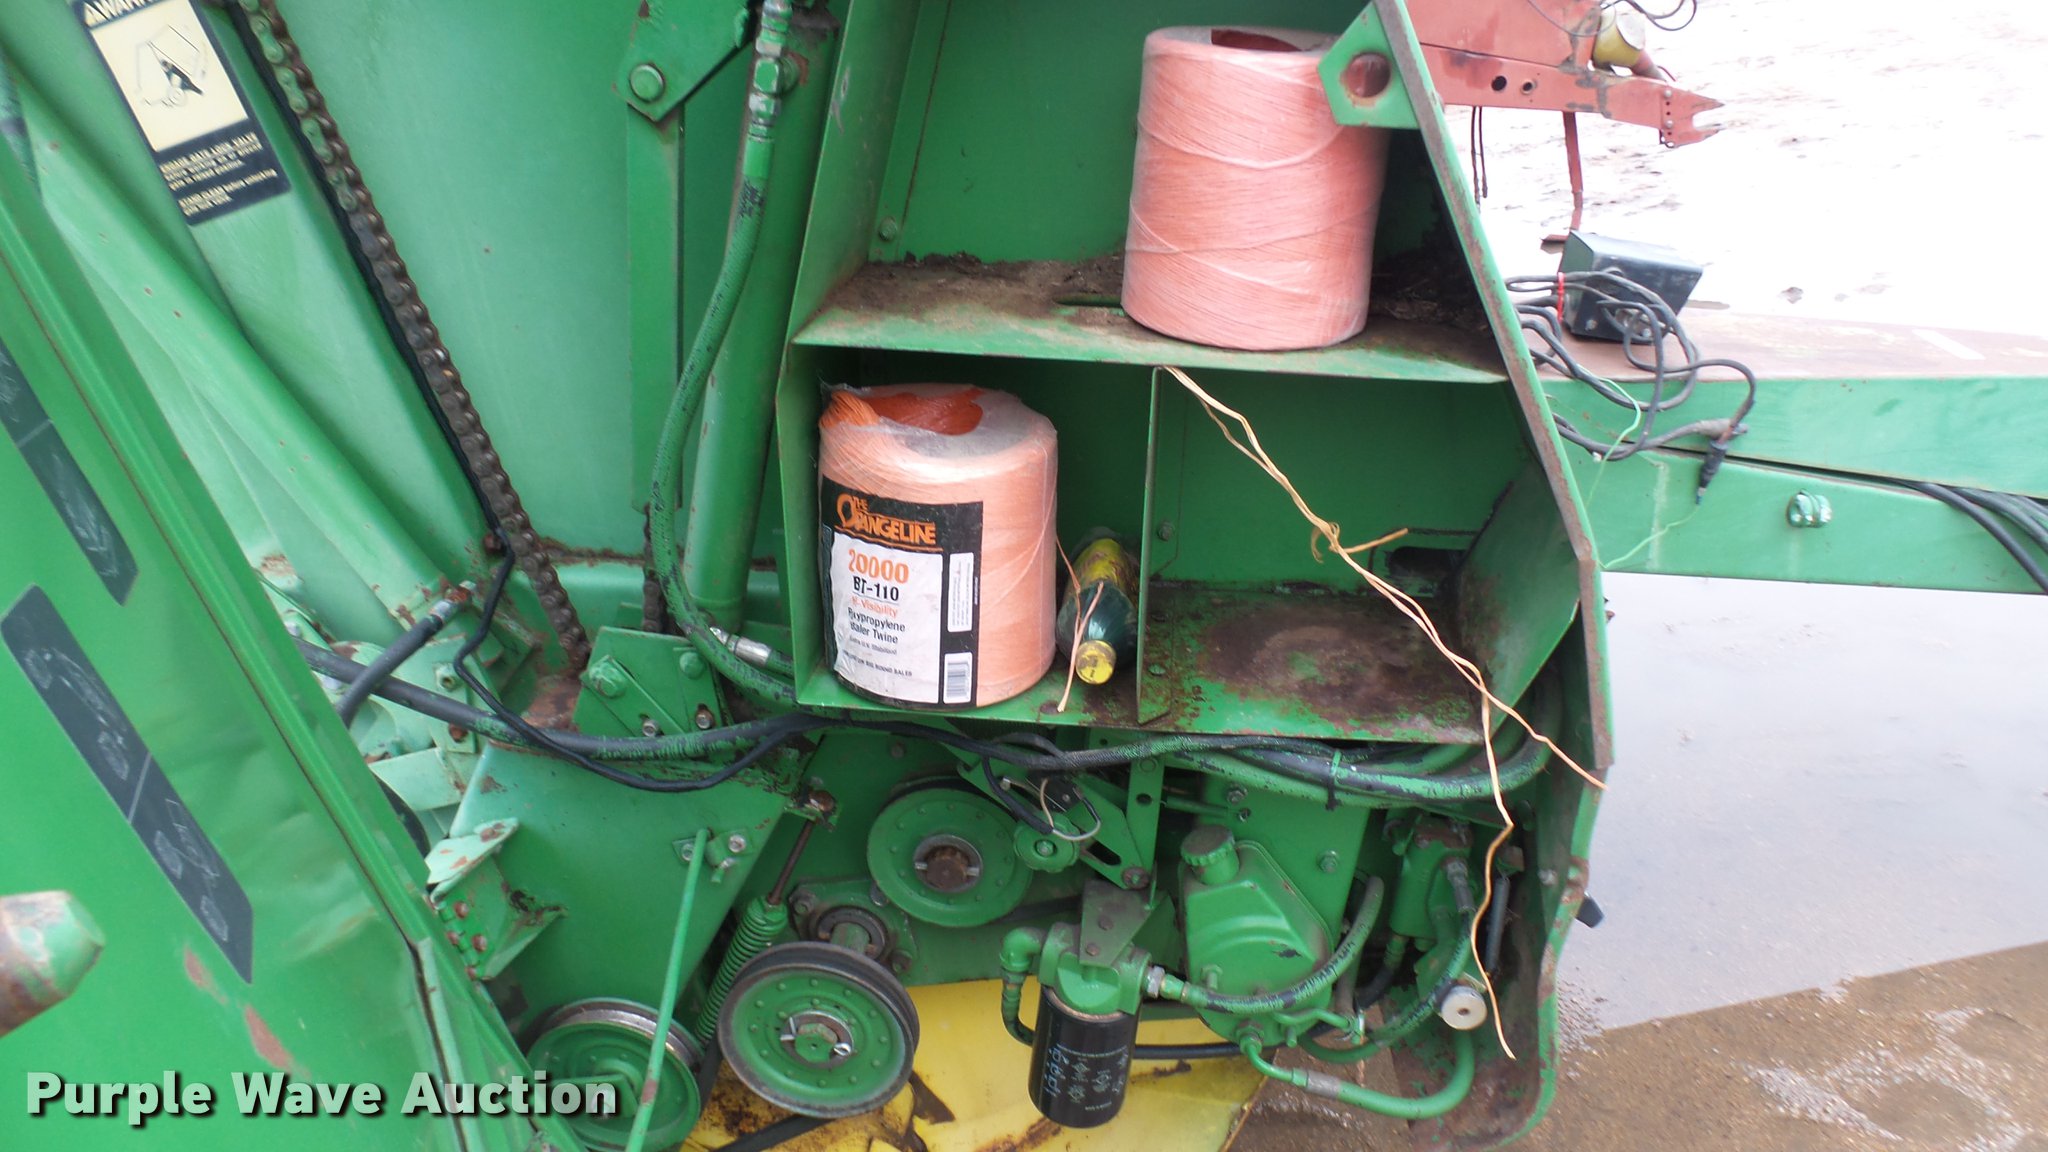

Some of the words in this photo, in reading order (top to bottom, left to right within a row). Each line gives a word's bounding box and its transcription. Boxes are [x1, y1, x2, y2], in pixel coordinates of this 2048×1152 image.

[852, 495, 868, 511] THE
[837, 493, 937, 545] ORANGELINE
[848, 548, 909, 584] 20000
[853, 575, 900, 601] BT-110
[873, 628, 899, 644] Twine
